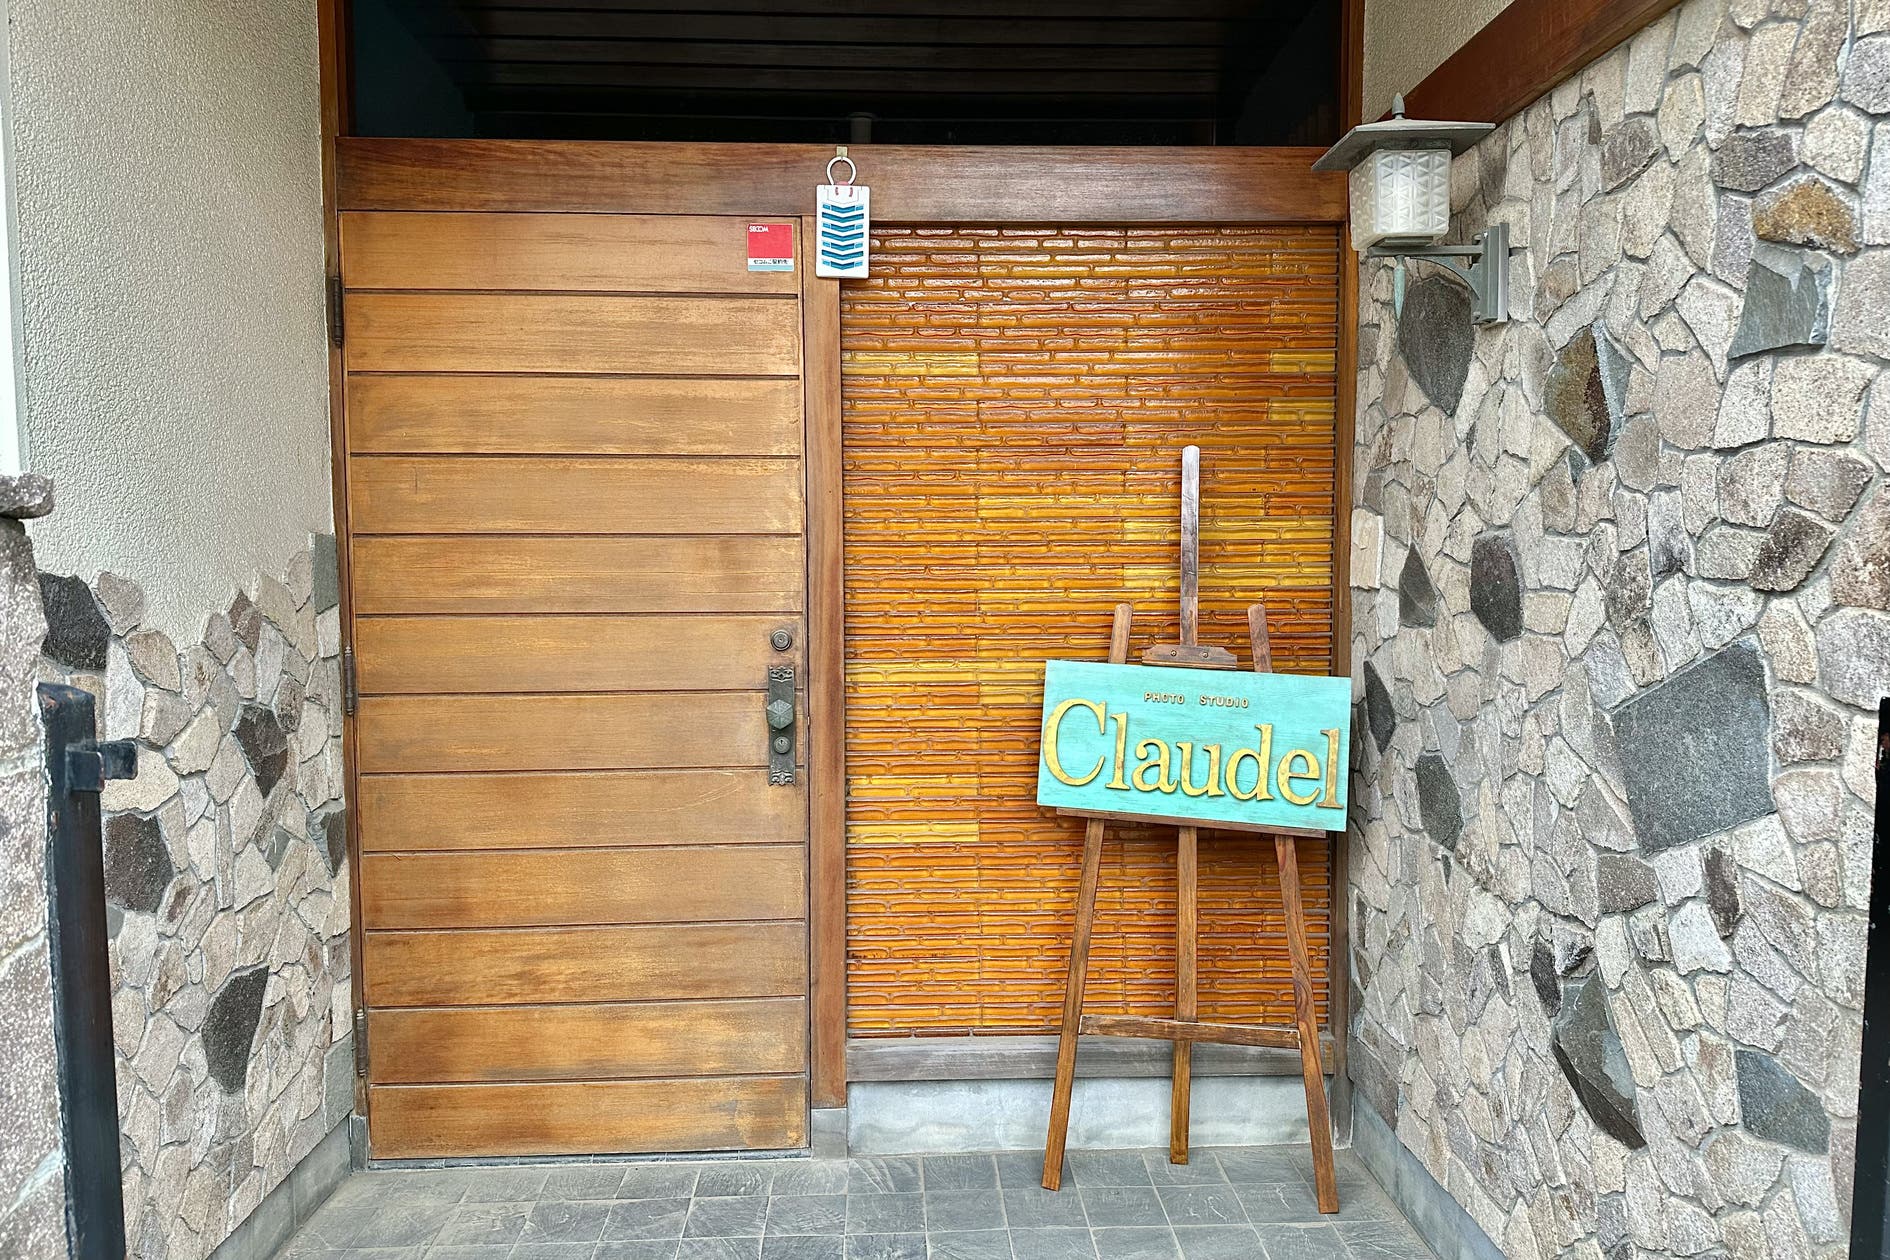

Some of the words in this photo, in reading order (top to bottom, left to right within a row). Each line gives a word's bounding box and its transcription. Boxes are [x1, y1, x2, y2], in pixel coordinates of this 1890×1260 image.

[1144, 692, 1185, 704] PHOTO
[1199, 695, 1249, 708] STUDIO
[1043, 698, 1344, 809] Claudel
